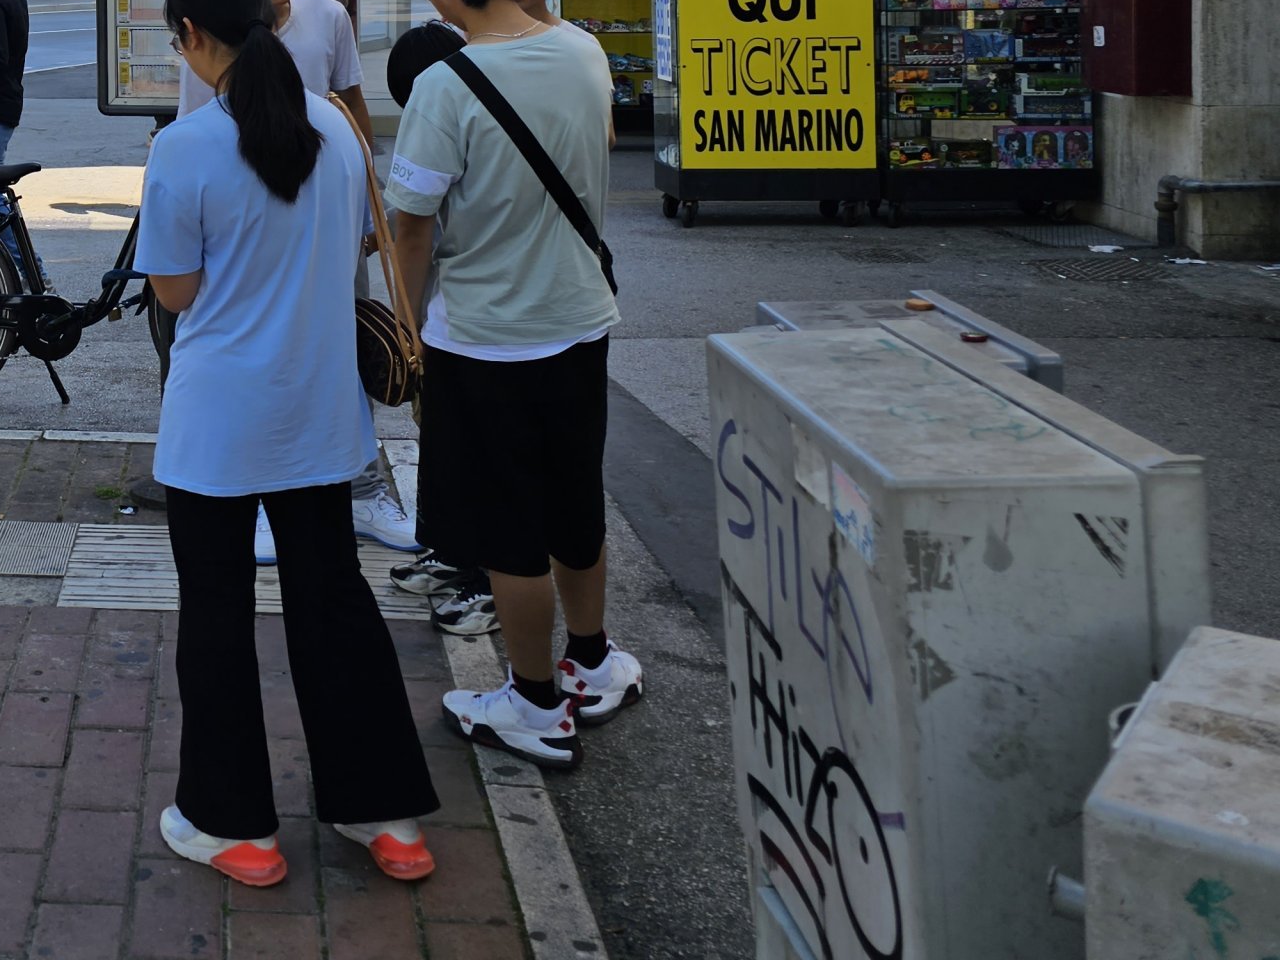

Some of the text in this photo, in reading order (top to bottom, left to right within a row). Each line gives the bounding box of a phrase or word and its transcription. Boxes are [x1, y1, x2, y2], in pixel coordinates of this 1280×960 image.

[691, 37, 861, 96] TICKET
[694, 108, 863, 152] SAN MARINO
[391, 162, 415, 182] BOY
